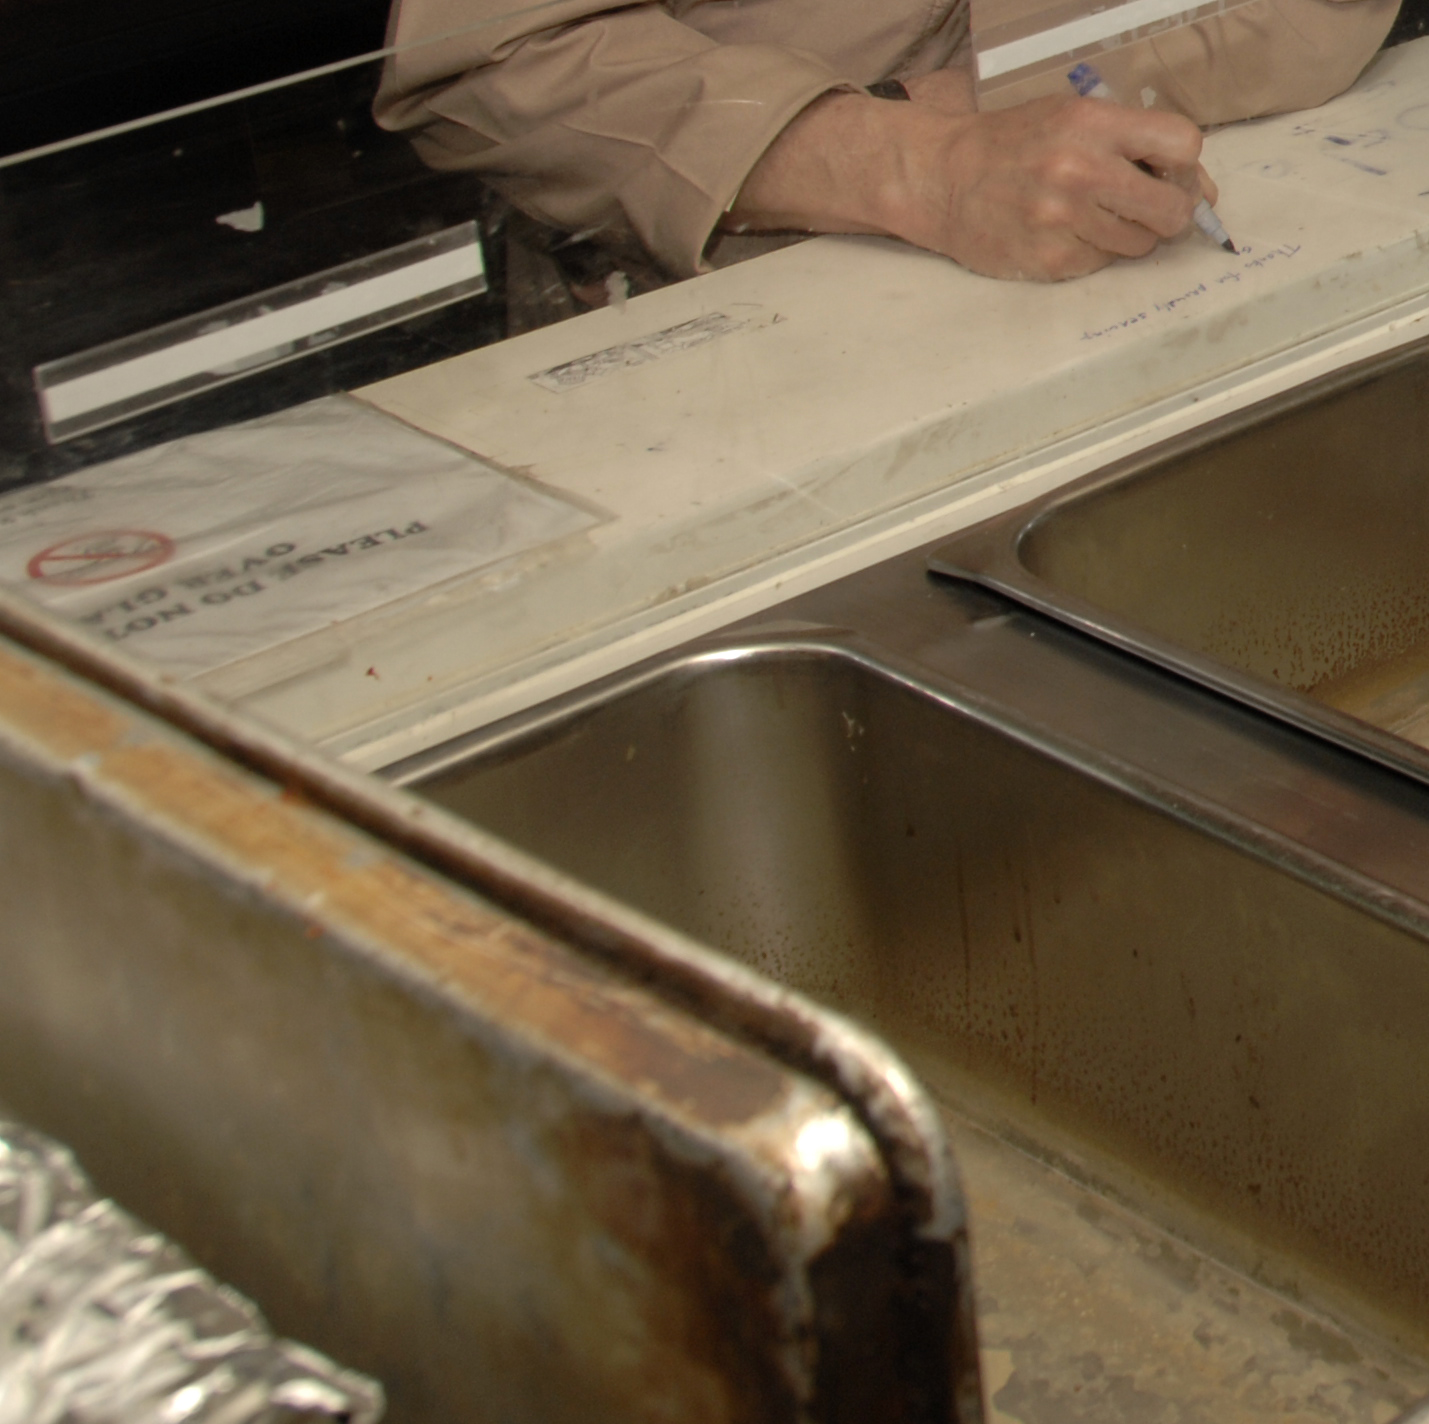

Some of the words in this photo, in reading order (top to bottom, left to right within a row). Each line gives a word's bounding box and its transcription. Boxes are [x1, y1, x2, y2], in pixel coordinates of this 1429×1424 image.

[1244, 243, 1302, 269] Thanks
[173, 541, 299, 590] OVER
[274, 520, 431, 581] PLEASE
[80, 587, 168, 626] GLA
[201, 579, 267, 606] DO
